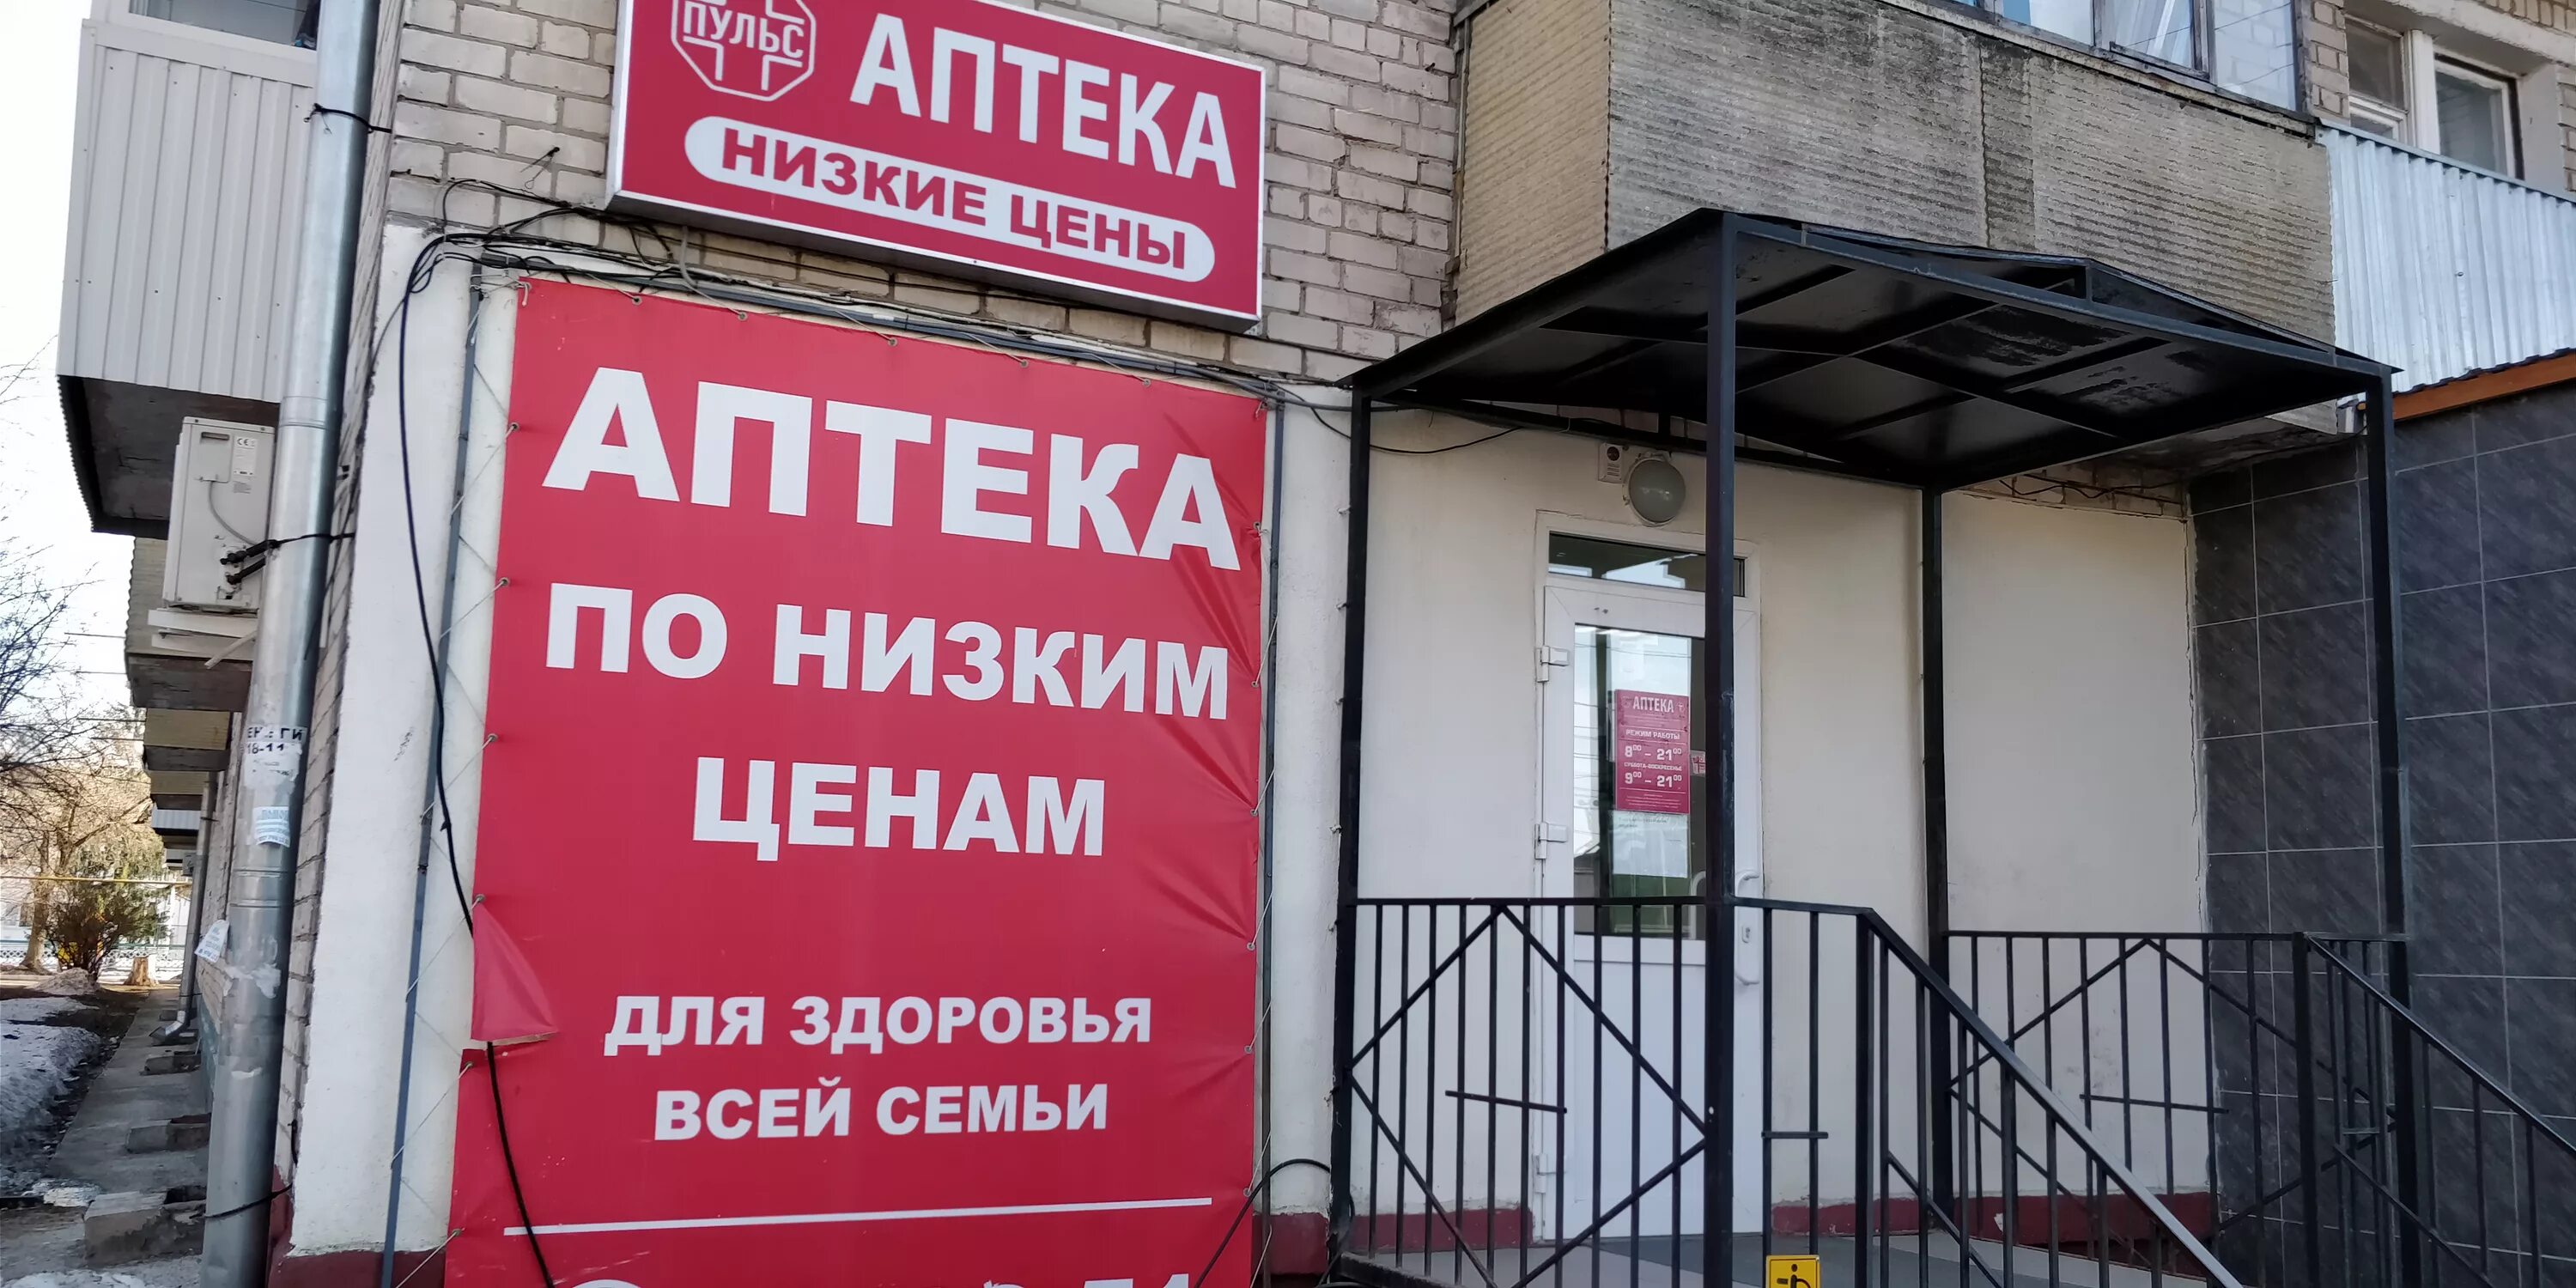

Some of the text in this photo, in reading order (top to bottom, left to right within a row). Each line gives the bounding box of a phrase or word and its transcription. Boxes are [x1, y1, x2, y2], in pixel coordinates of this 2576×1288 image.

[683, 1, 805, 58] ПУЛЬС
[849, 14, 1236, 189] АПТЕКА
[722, 129, 986, 227] НИЗКИЕ
[1010, 195, 1186, 269] ЦЕНЫ
[542, 367, 1241, 571] АПТЕКА
[546, 582, 1229, 720] ПО НИЗКИМ
[1625, 729, 1652, 738] РЕЖИМ
[1633, 696, 1674, 713] АПТЕКА
[693, 756, 1105, 862] ЦЕНАМ
[604, 995, 1151, 1056] ДЛЯ ЗДОРОВЬЯ
[654, 1076, 1108, 1141] ВСЕЙ СЕМЬИ
